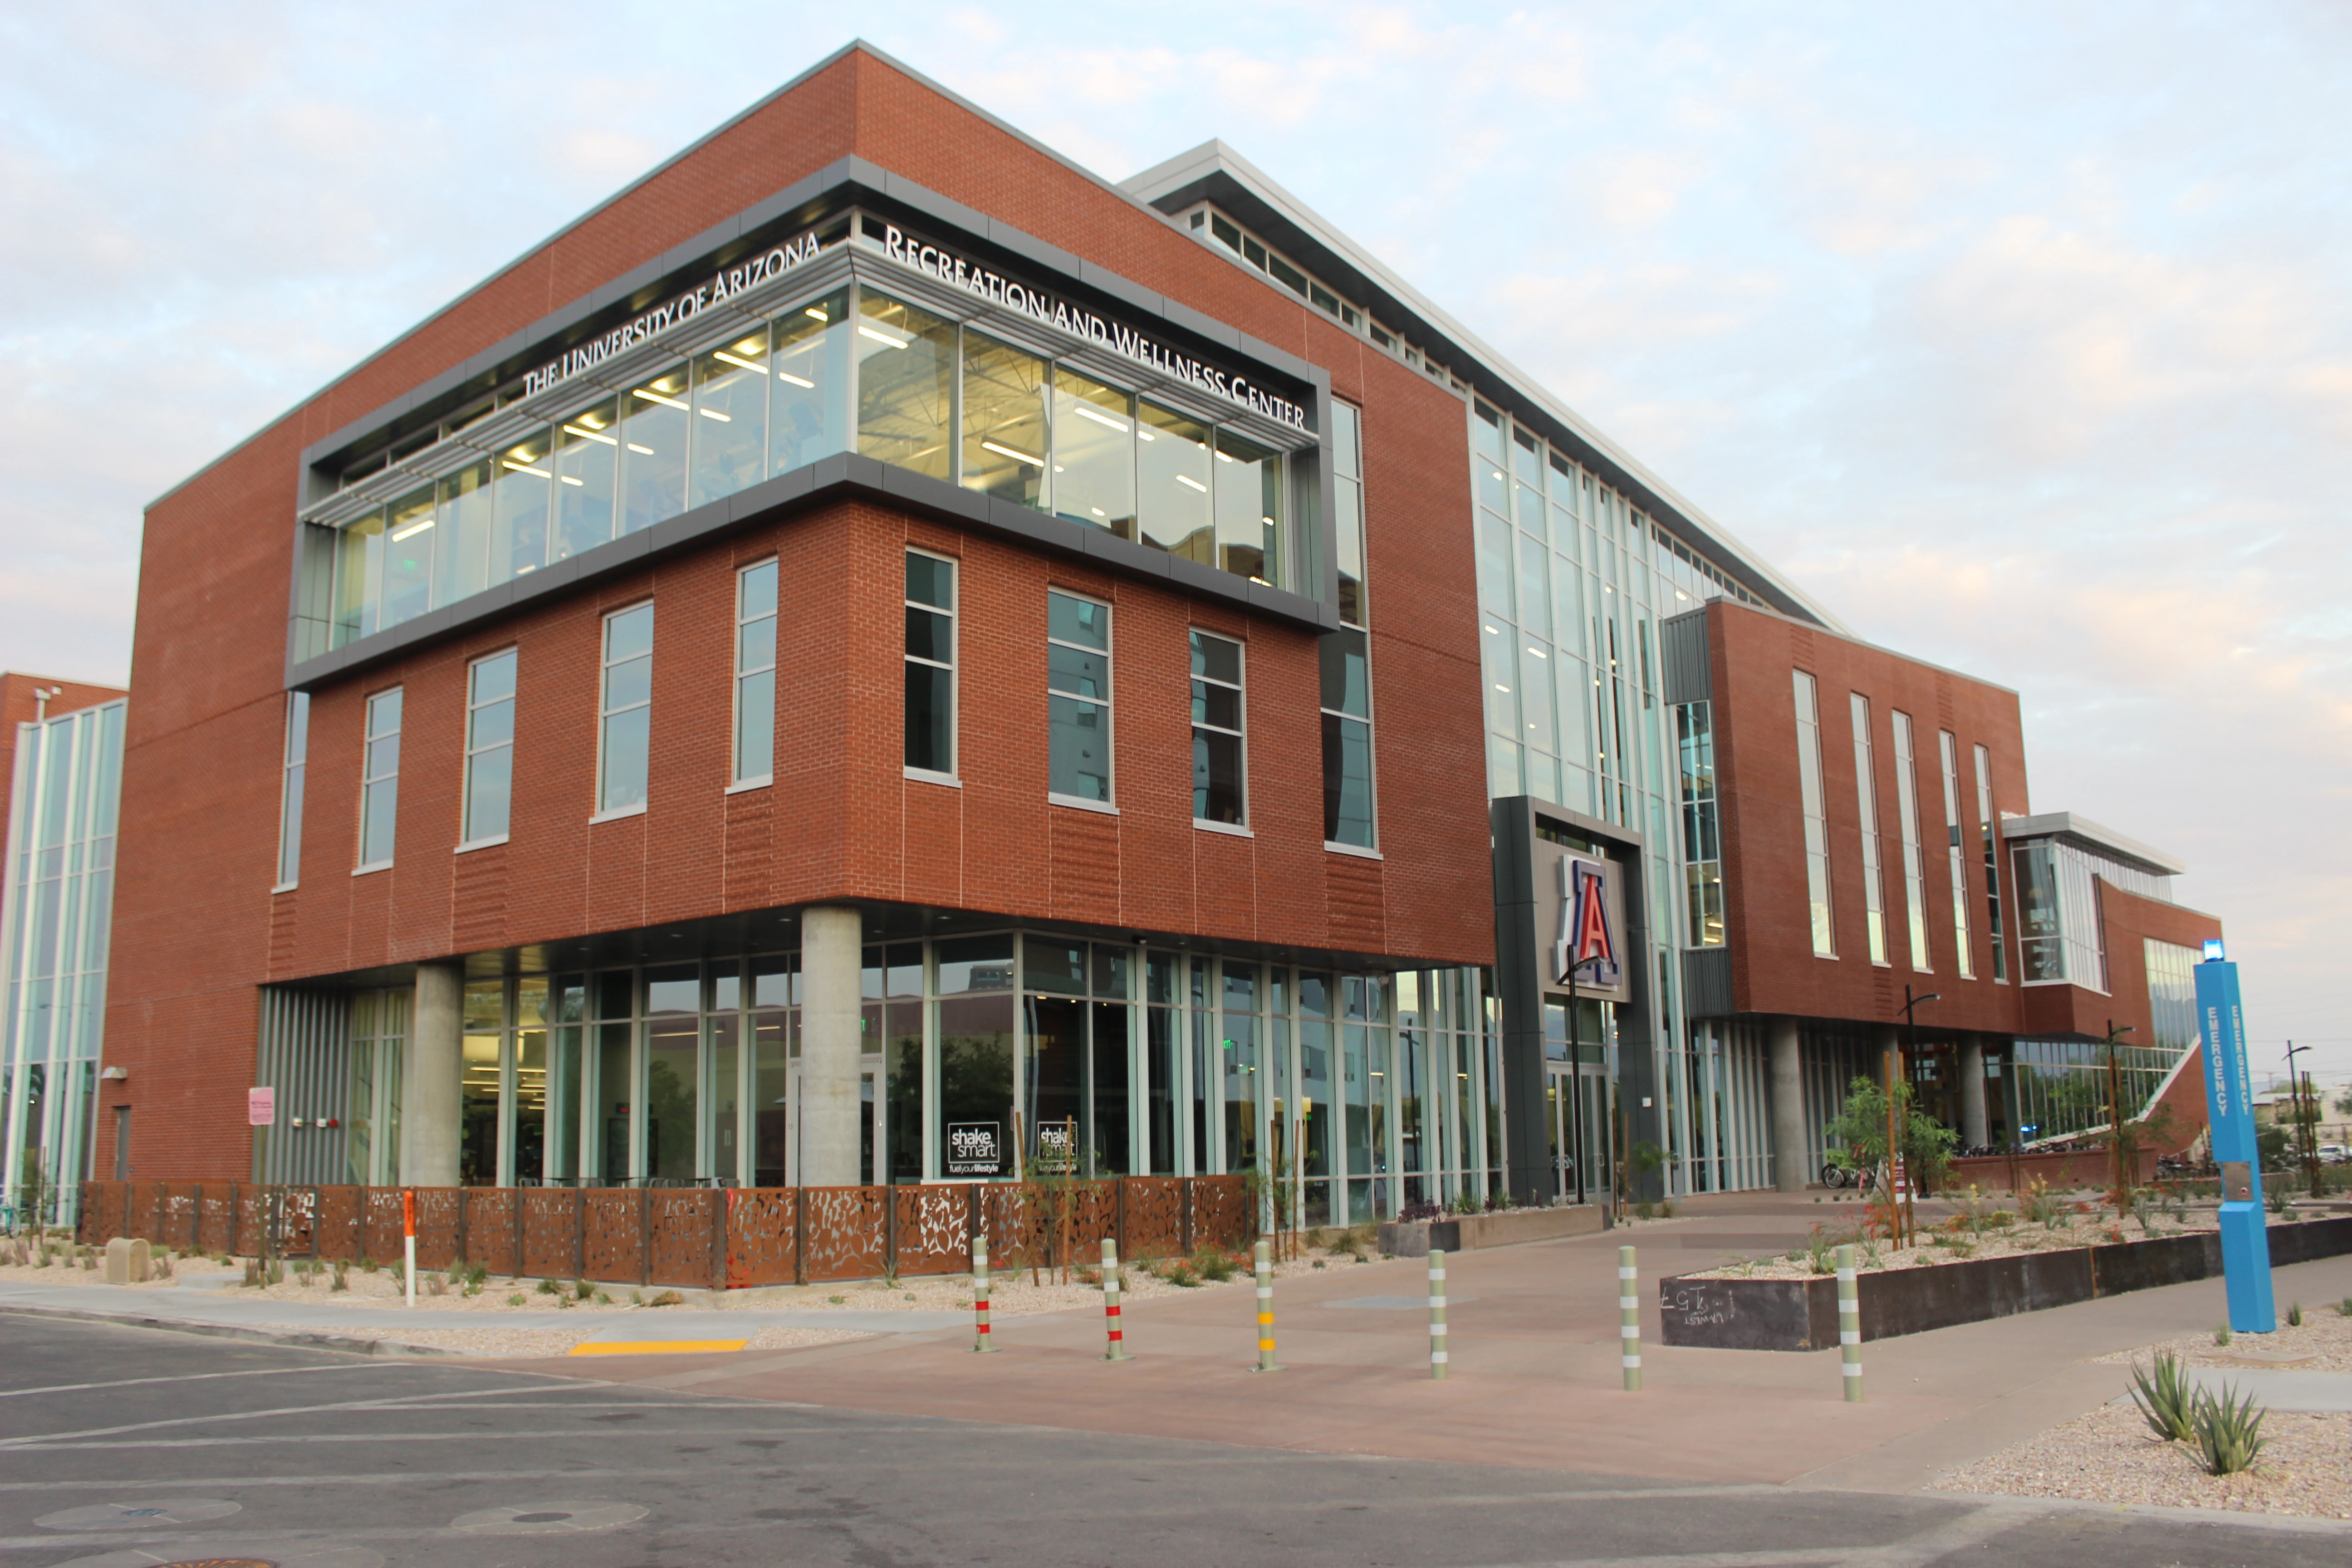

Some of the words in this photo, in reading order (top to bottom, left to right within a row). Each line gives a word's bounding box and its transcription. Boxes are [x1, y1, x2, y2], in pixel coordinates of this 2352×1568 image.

[523, 363, 559, 397] THE
[562, 302, 676, 379] UNIVERSITY
[678, 286, 708, 321] OF
[712, 232, 821, 305] ARIZONA
[884, 224, 1045, 319] RECREATION
[1053, 301, 1107, 344] AND
[1112, 322, 1226, 396] WELLNESS
[1231, 376, 1305, 431] CENTER
[2207, 1007, 2227, 1117] EMERGENCY
[2231, 1005, 2249, 1116] EMERGENCY
[952, 1128, 991, 1146] shake
[957, 1142, 996, 1158] smart
